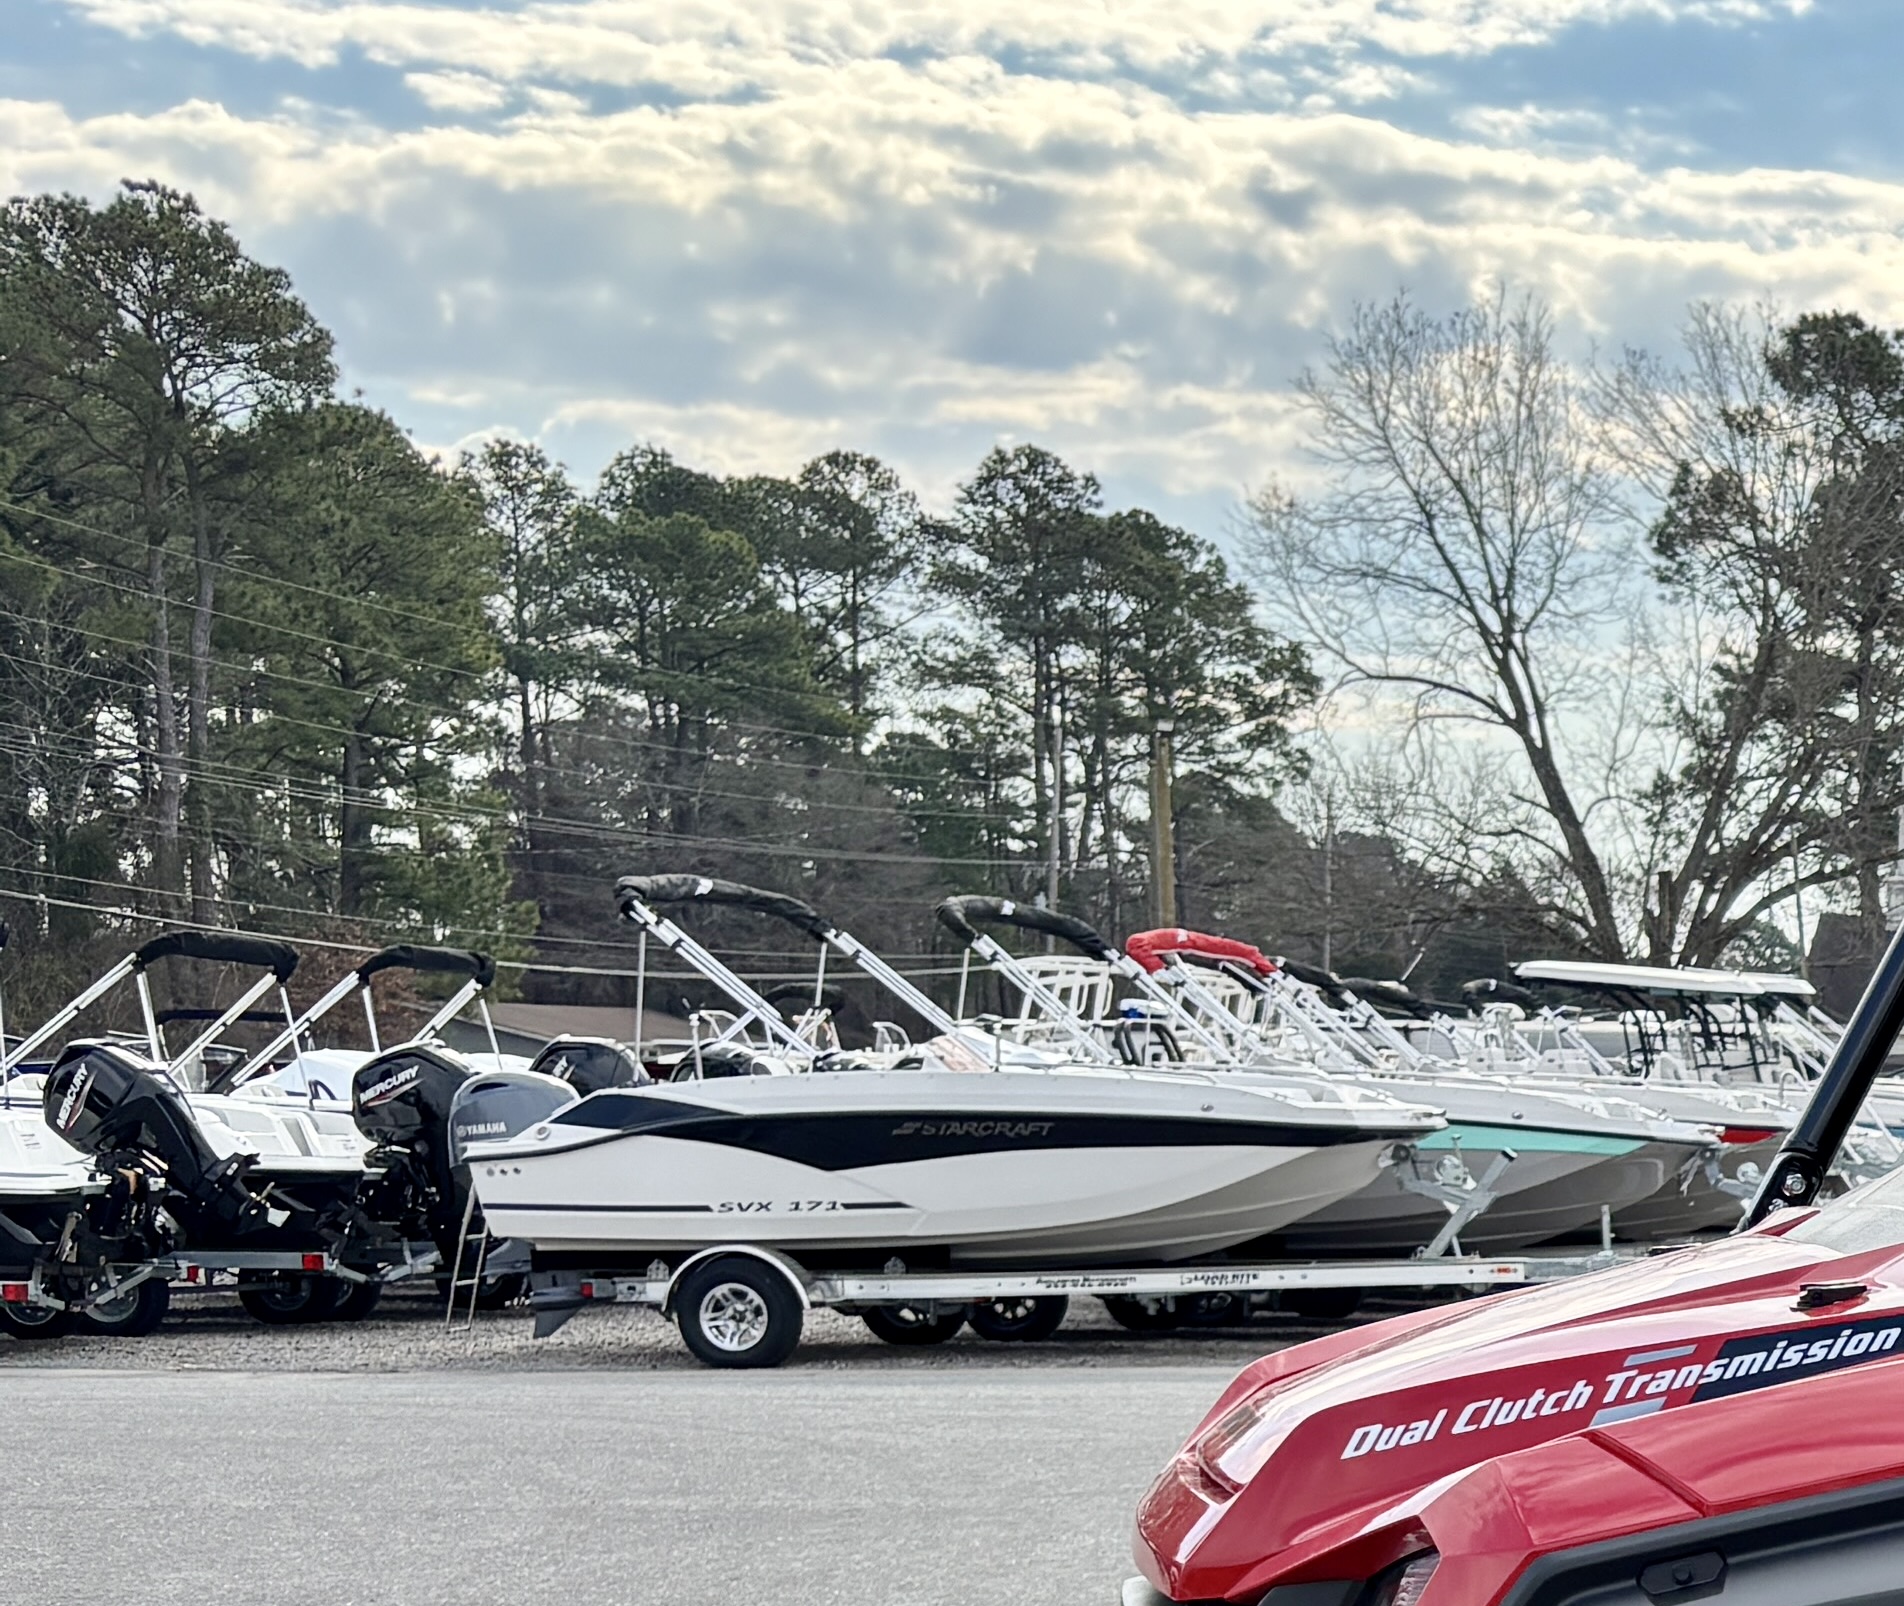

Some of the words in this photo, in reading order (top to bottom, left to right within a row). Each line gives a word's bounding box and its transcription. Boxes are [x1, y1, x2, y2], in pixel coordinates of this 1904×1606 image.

[359, 1064, 420, 1105] MERCURY
[466, 1121, 507, 1136] YAMAHA
[920, 1121, 1055, 1138] STARCRAFT
[717, 1201, 773, 1213] SVX
[788, 1201, 840, 1212] 171
[1340, 1408, 1448, 1460] Dual
[1451, 1379, 1594, 1435] Clutch
[1602, 1326, 1903, 1405] Transmission
